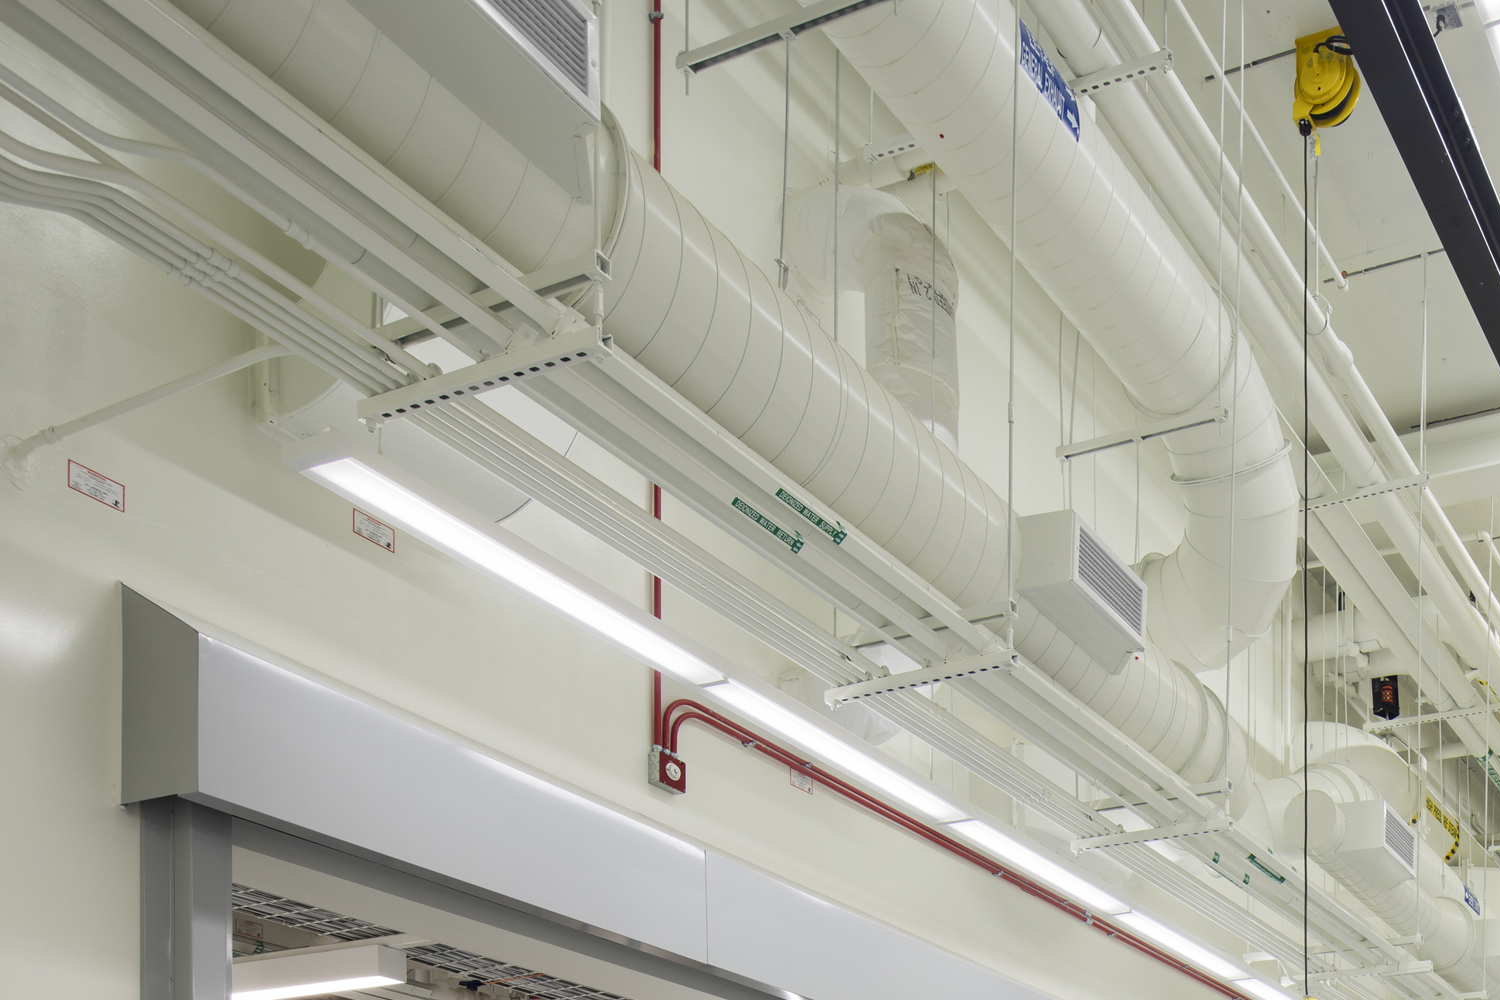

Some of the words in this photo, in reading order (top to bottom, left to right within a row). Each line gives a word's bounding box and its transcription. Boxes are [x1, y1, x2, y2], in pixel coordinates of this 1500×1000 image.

[735, 500, 760, 521] DEIONIZED
[759, 516, 777, 533] WATER
[775, 529, 796, 546] RETURN
[779, 491, 803, 512] DEIONIZED
[802, 507, 820, 524] WATER
[819, 520, 838, 537] SUPPLY
